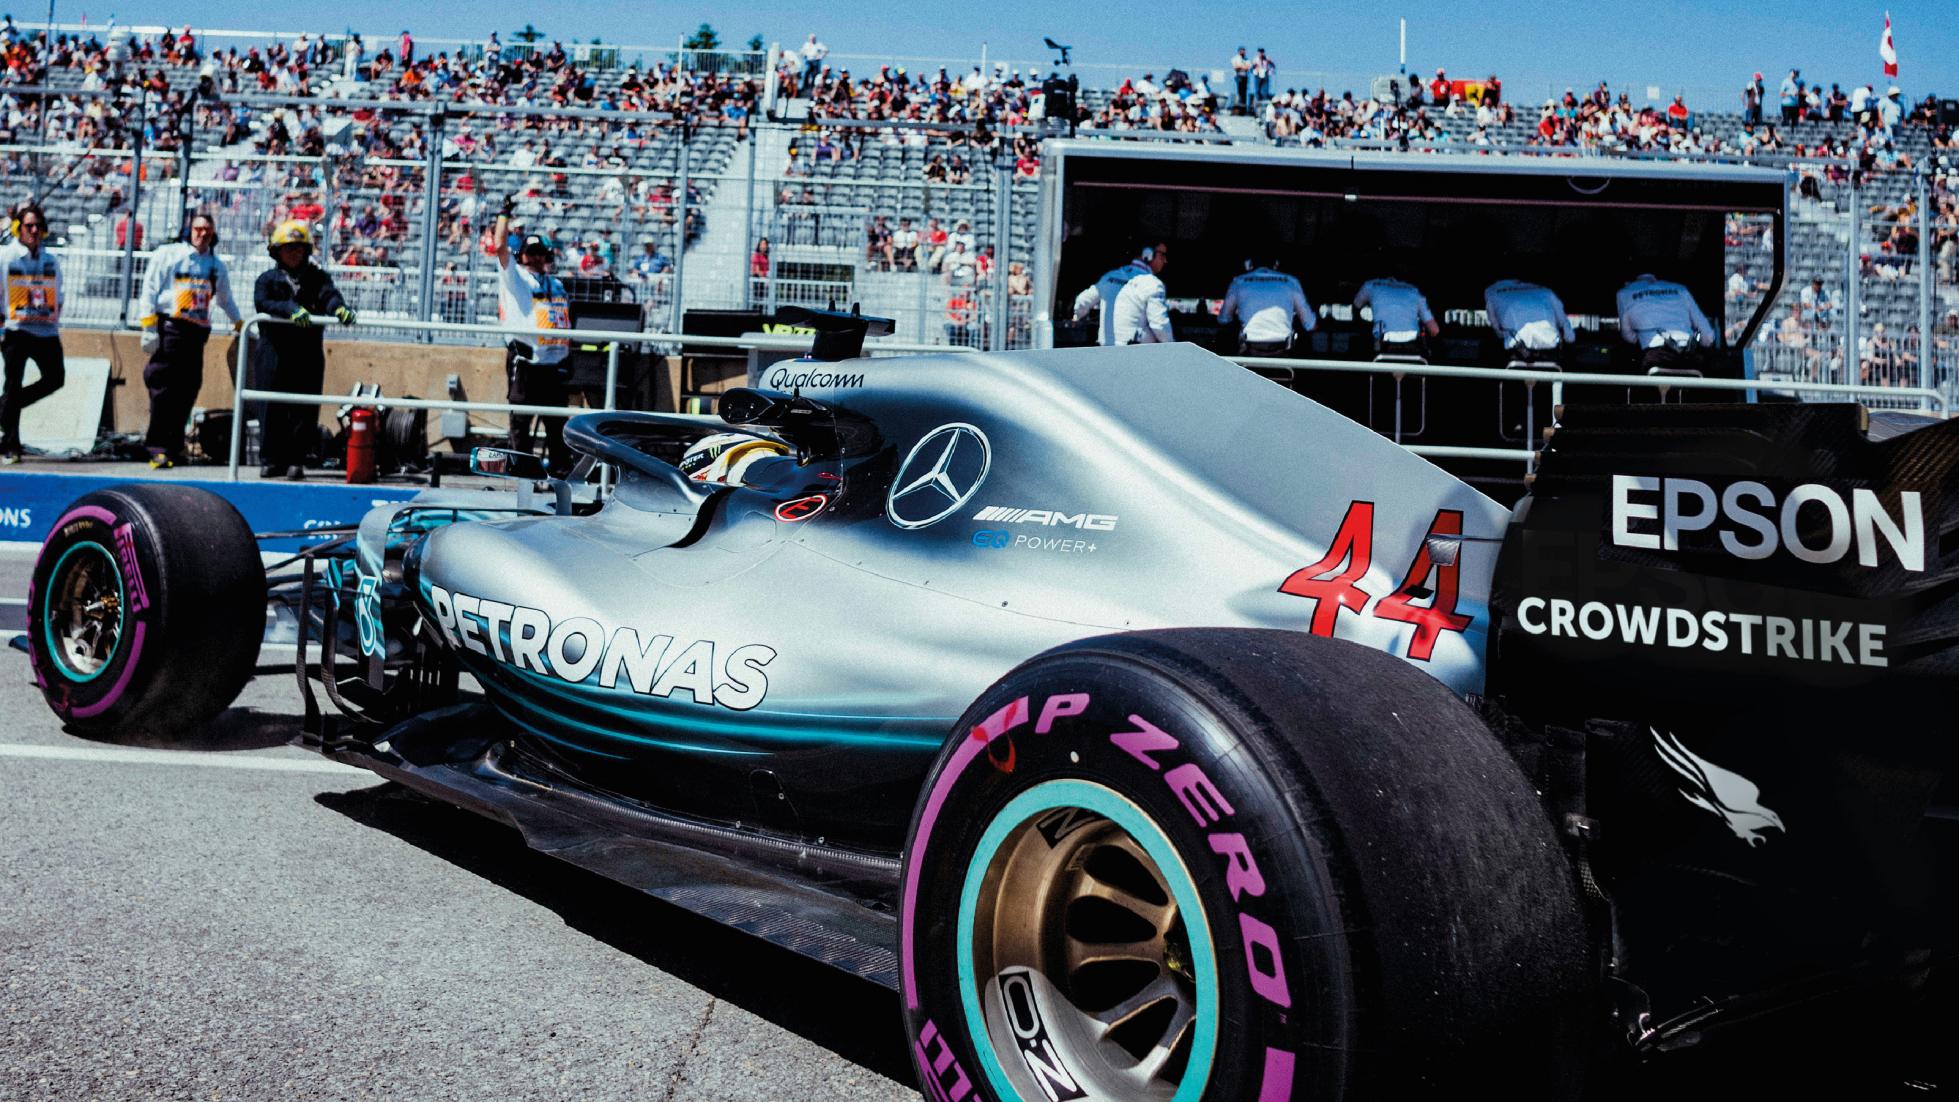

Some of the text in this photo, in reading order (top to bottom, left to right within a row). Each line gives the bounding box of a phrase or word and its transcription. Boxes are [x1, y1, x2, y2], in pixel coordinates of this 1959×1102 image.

[770, 368, 865, 390] Qualcomm
[1612, 474, 1925, 572] EPSON
[1277, 500, 1475, 662] 44
[1516, 596, 1889, 667] CROWDSTRIKE
[430, 584, 778, 712] PETRONAS
[1035, 693, 1292, 1009] P ZERO
